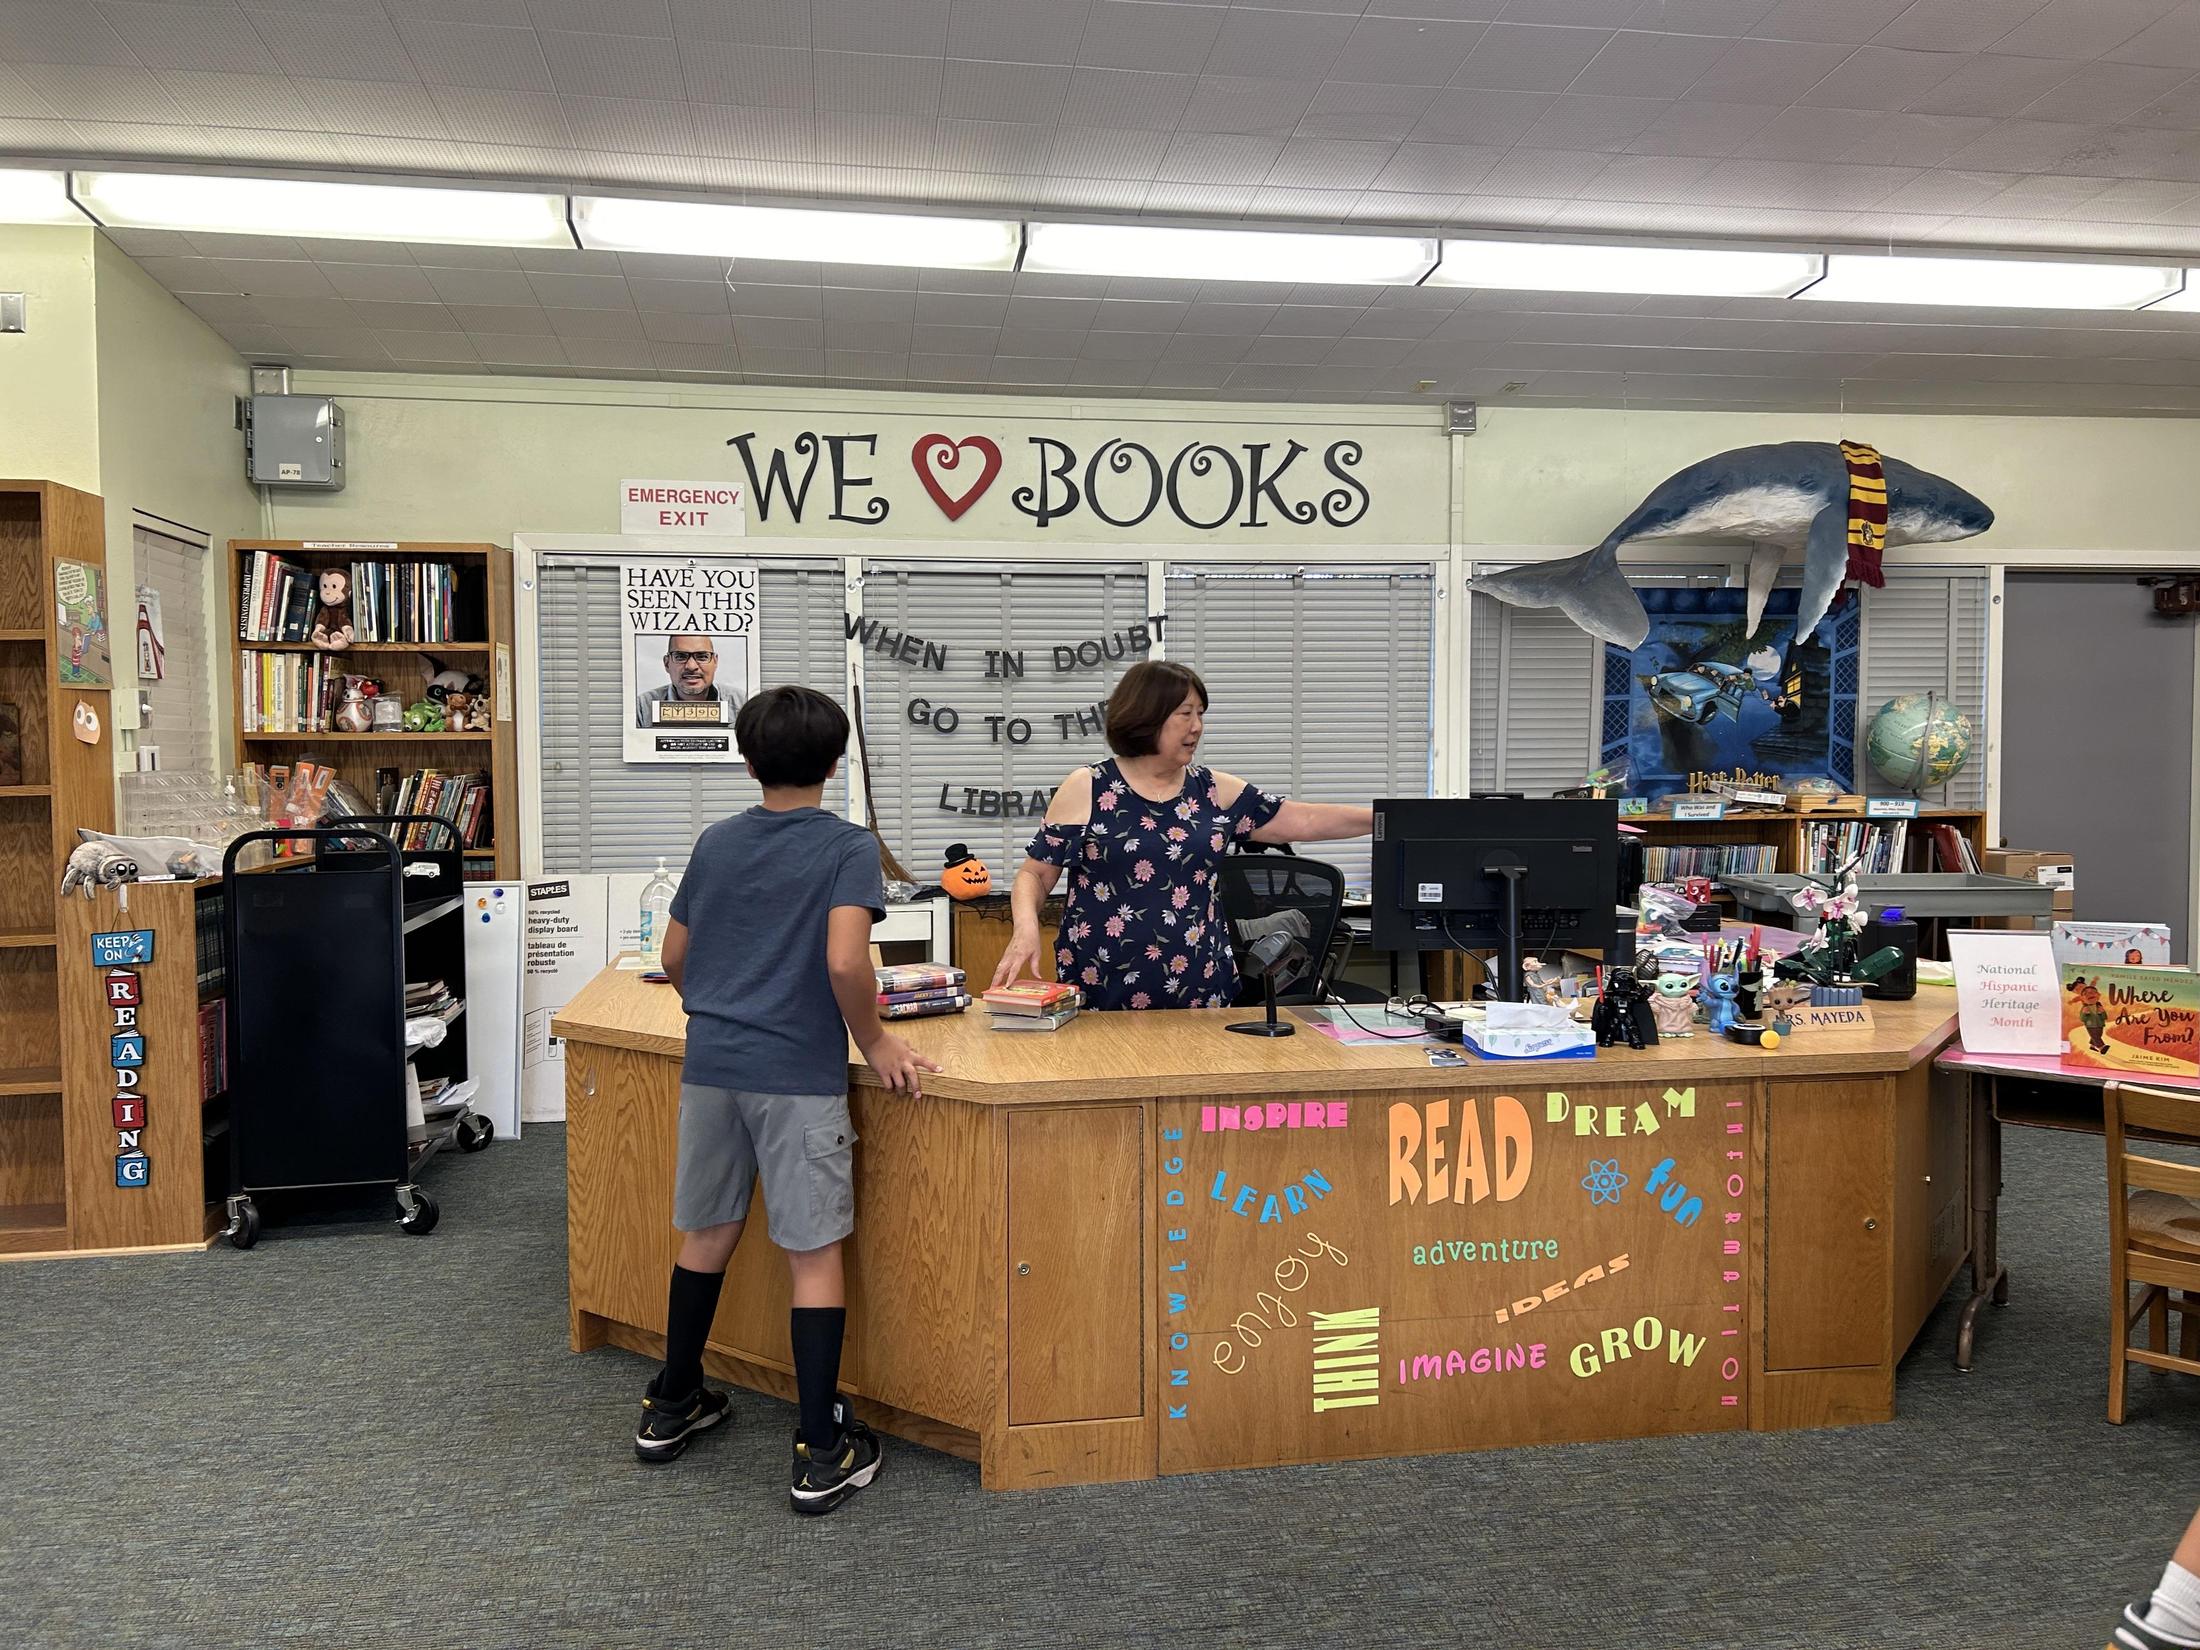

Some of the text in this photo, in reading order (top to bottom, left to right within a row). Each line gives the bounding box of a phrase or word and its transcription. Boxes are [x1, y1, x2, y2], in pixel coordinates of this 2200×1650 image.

[727, 432, 1370, 530] WE BOOKS
[628, 488, 740, 505] EMERGENCY
[659, 511, 709, 526] EXIT
[627, 568, 756, 589] HAVE YOU
[240, 574, 252, 631] IMPRESSIONISTS
[627, 589, 755, 611] SEEN THIS
[629, 612, 754, 632] WIZARD?
[844, 612, 1168, 679] WHEN IN DOUBT
[907, 698, 959, 734] GO
[984, 716, 1032, 745] TO
[530, 885, 567, 897] STAPLES
[528, 917, 570, 925] heavy-duty
[528, 925, 579, 935] display board
[97, 936, 129, 949] KEEP
[557, 941, 567, 949] de
[104, 948, 122, 960] ON
[527, 950, 575, 959] présentation
[527, 959, 556, 967] robuste
[1977, 964, 2038, 975] National
[1979, 980, 2038, 995] Hispanic
[2108, 983, 2174, 1006] Where
[1981, 997, 2040, 1013] Heritage
[1810, 1010, 1866, 1026] MAYEDA
[1989, 1016, 2034, 1028] Month
[2115, 1007, 2195, 1028] Are You
[2143, 1027, 2195, 1045] From?
[2155, 1055, 2171, 1063] KIM
[110, 983, 145, 1180] READING
[1201, 1086, 1696, 1207] INSPIRE READ DREAM
[1210, 1168, 1333, 1224] LEARN
[1643, 1157, 1704, 1228] fun
[1412, 1237, 1560, 1266] adventure
[1164, 1127, 1189, 1419] KNOWLEDGE
[1495, 1253, 1632, 1325] IDEAS
[1212, 1232, 1349, 1375] enjoy
[1569, 1316, 1707, 1379] GROW
[1306, 1306, 1380, 1413] THINK
[1399, 1342, 1548, 1385] IMAGINE
